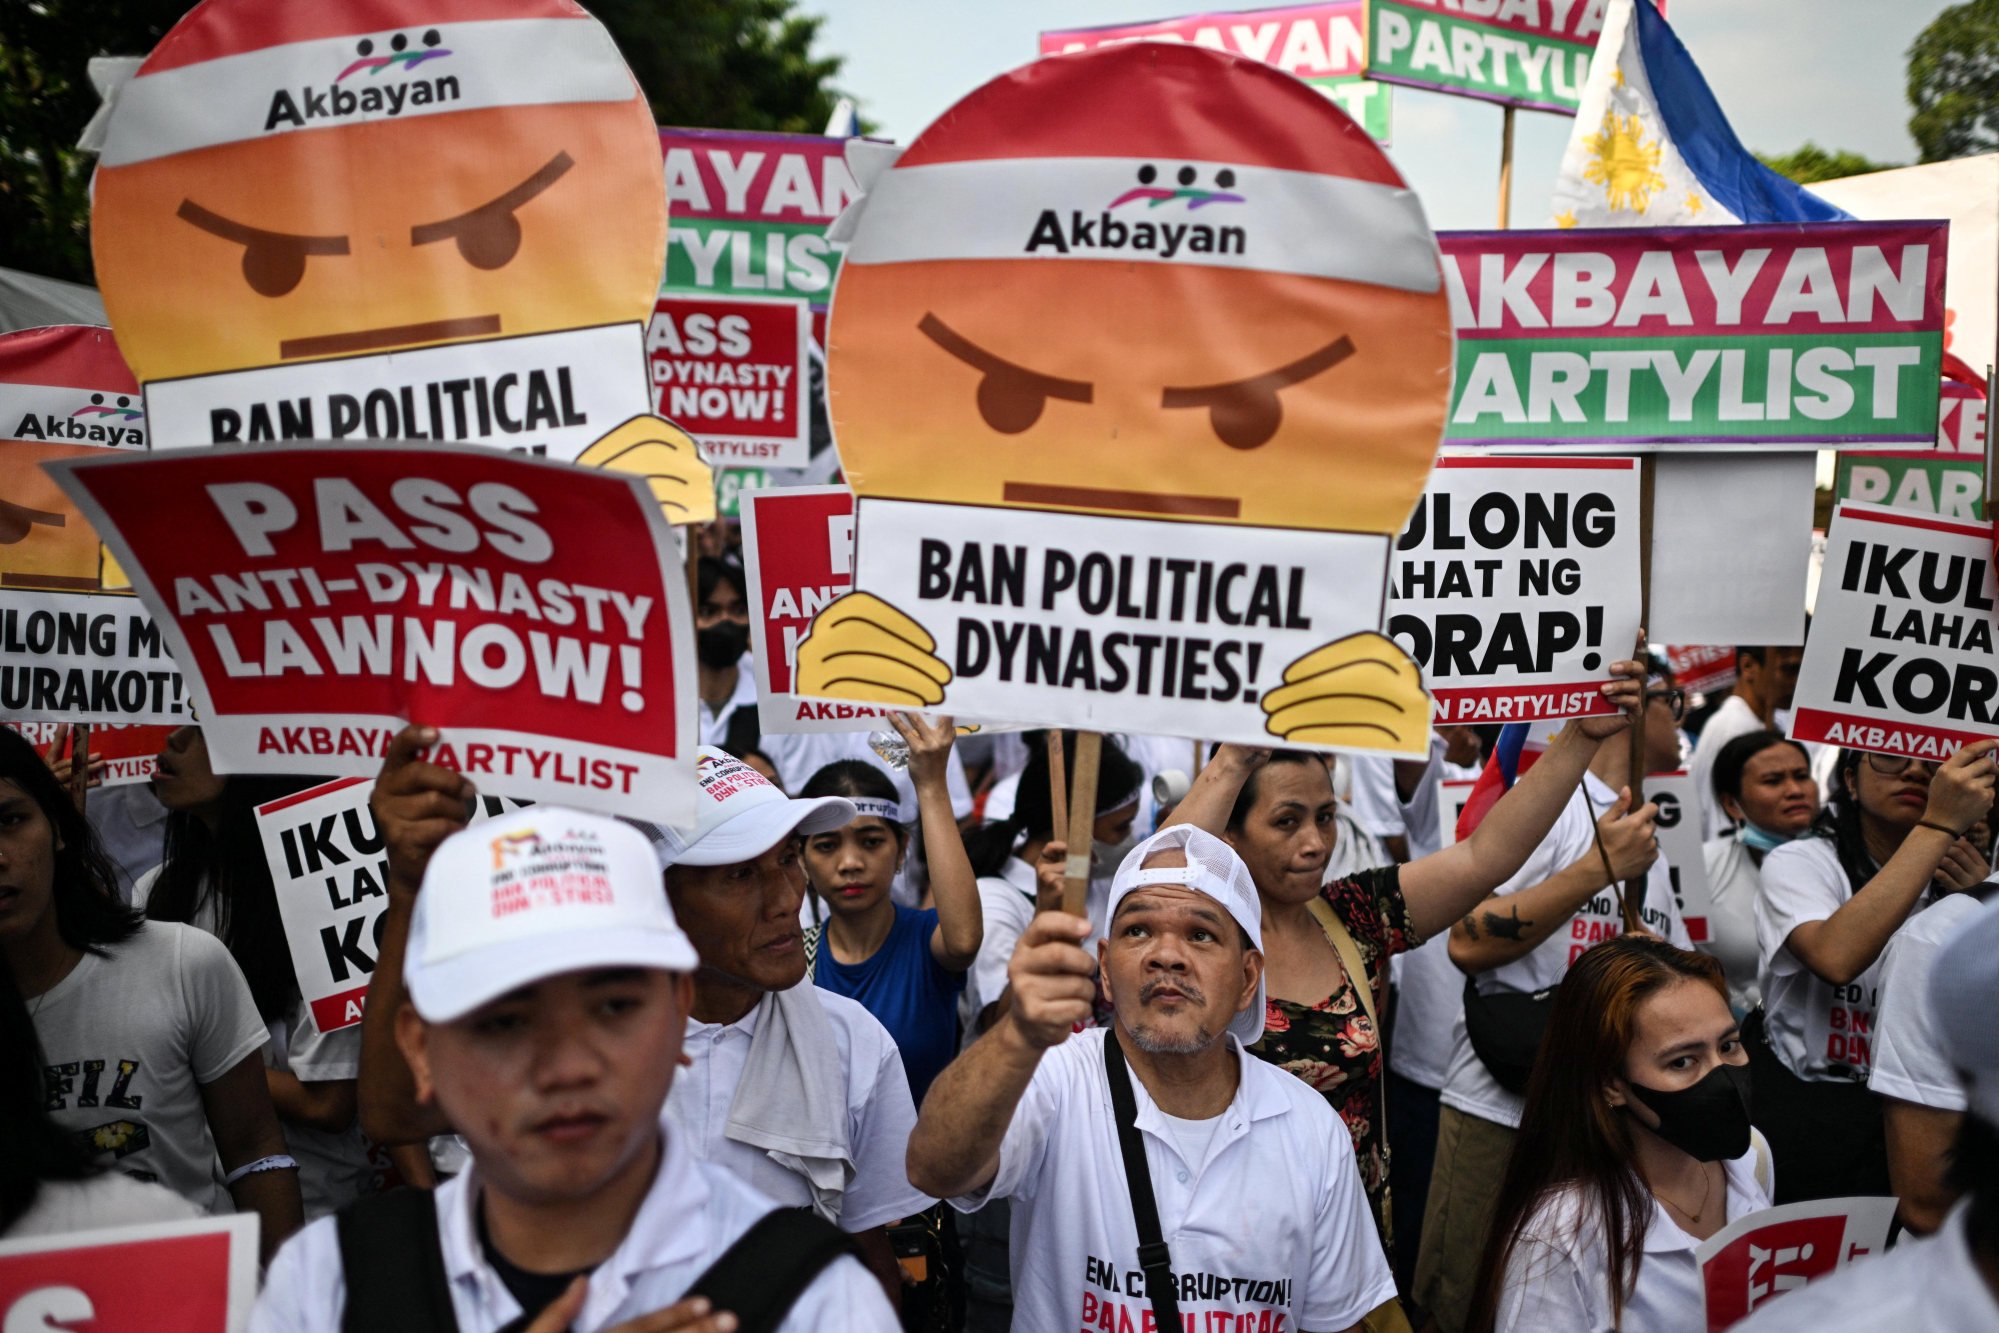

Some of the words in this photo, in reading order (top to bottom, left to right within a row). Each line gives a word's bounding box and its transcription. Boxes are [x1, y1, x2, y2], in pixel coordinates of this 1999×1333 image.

[264, 74, 460, 131] Akbayan
[1025, 209, 1246, 258] Akbayan
[670, 386, 785, 421] NOW!
[1452, 345, 1921, 423] ARTYLIST
[204, 477, 555, 564] PASS
[174, 560, 653, 641] ANTI-DYNASTY
[918, 538, 1028, 609] BAN
[1041, 547, 1312, 631] POLITICAL
[1391, 559, 1503, 600] HAT
[1518, 558, 1582, 597] NG
[0, 608, 116, 658] LONG
[127, 615, 176, 660] M
[1869, 603, 1999, 655] LAHA
[955, 616, 1262, 702] DYNASTIES!
[0, 665, 184, 715] URAKOT!
[1457, 690, 1598, 720] PARTYLIST
[1832, 646, 1999, 728] KOR
[325, 860, 391, 911] LA
